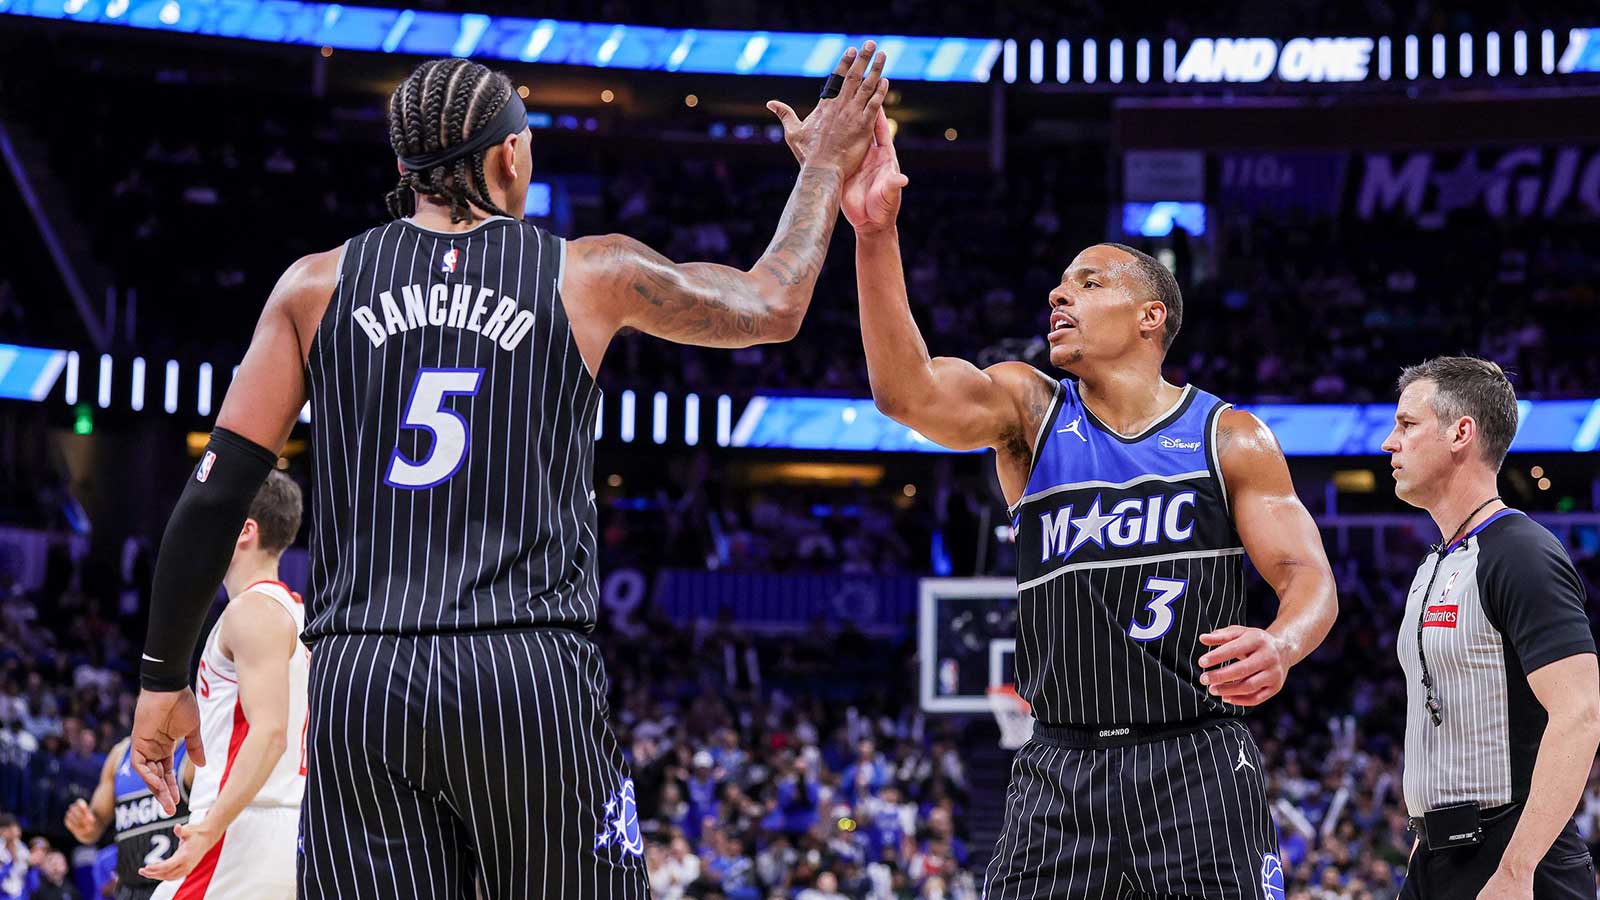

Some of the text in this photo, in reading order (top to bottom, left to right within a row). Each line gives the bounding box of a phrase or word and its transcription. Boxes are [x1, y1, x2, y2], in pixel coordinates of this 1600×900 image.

[1176, 37, 1374, 83] AND ONE
[352, 283, 535, 352] BANCHERO
[384, 367, 486, 490] 5
[1039, 489, 1198, 563] MAGIC
[1126, 575, 1189, 642] 3
[1424, 610, 1457, 623] Emirates
[1099, 728, 1130, 738] ORLANDO
[144, 834, 171, 866] 2
